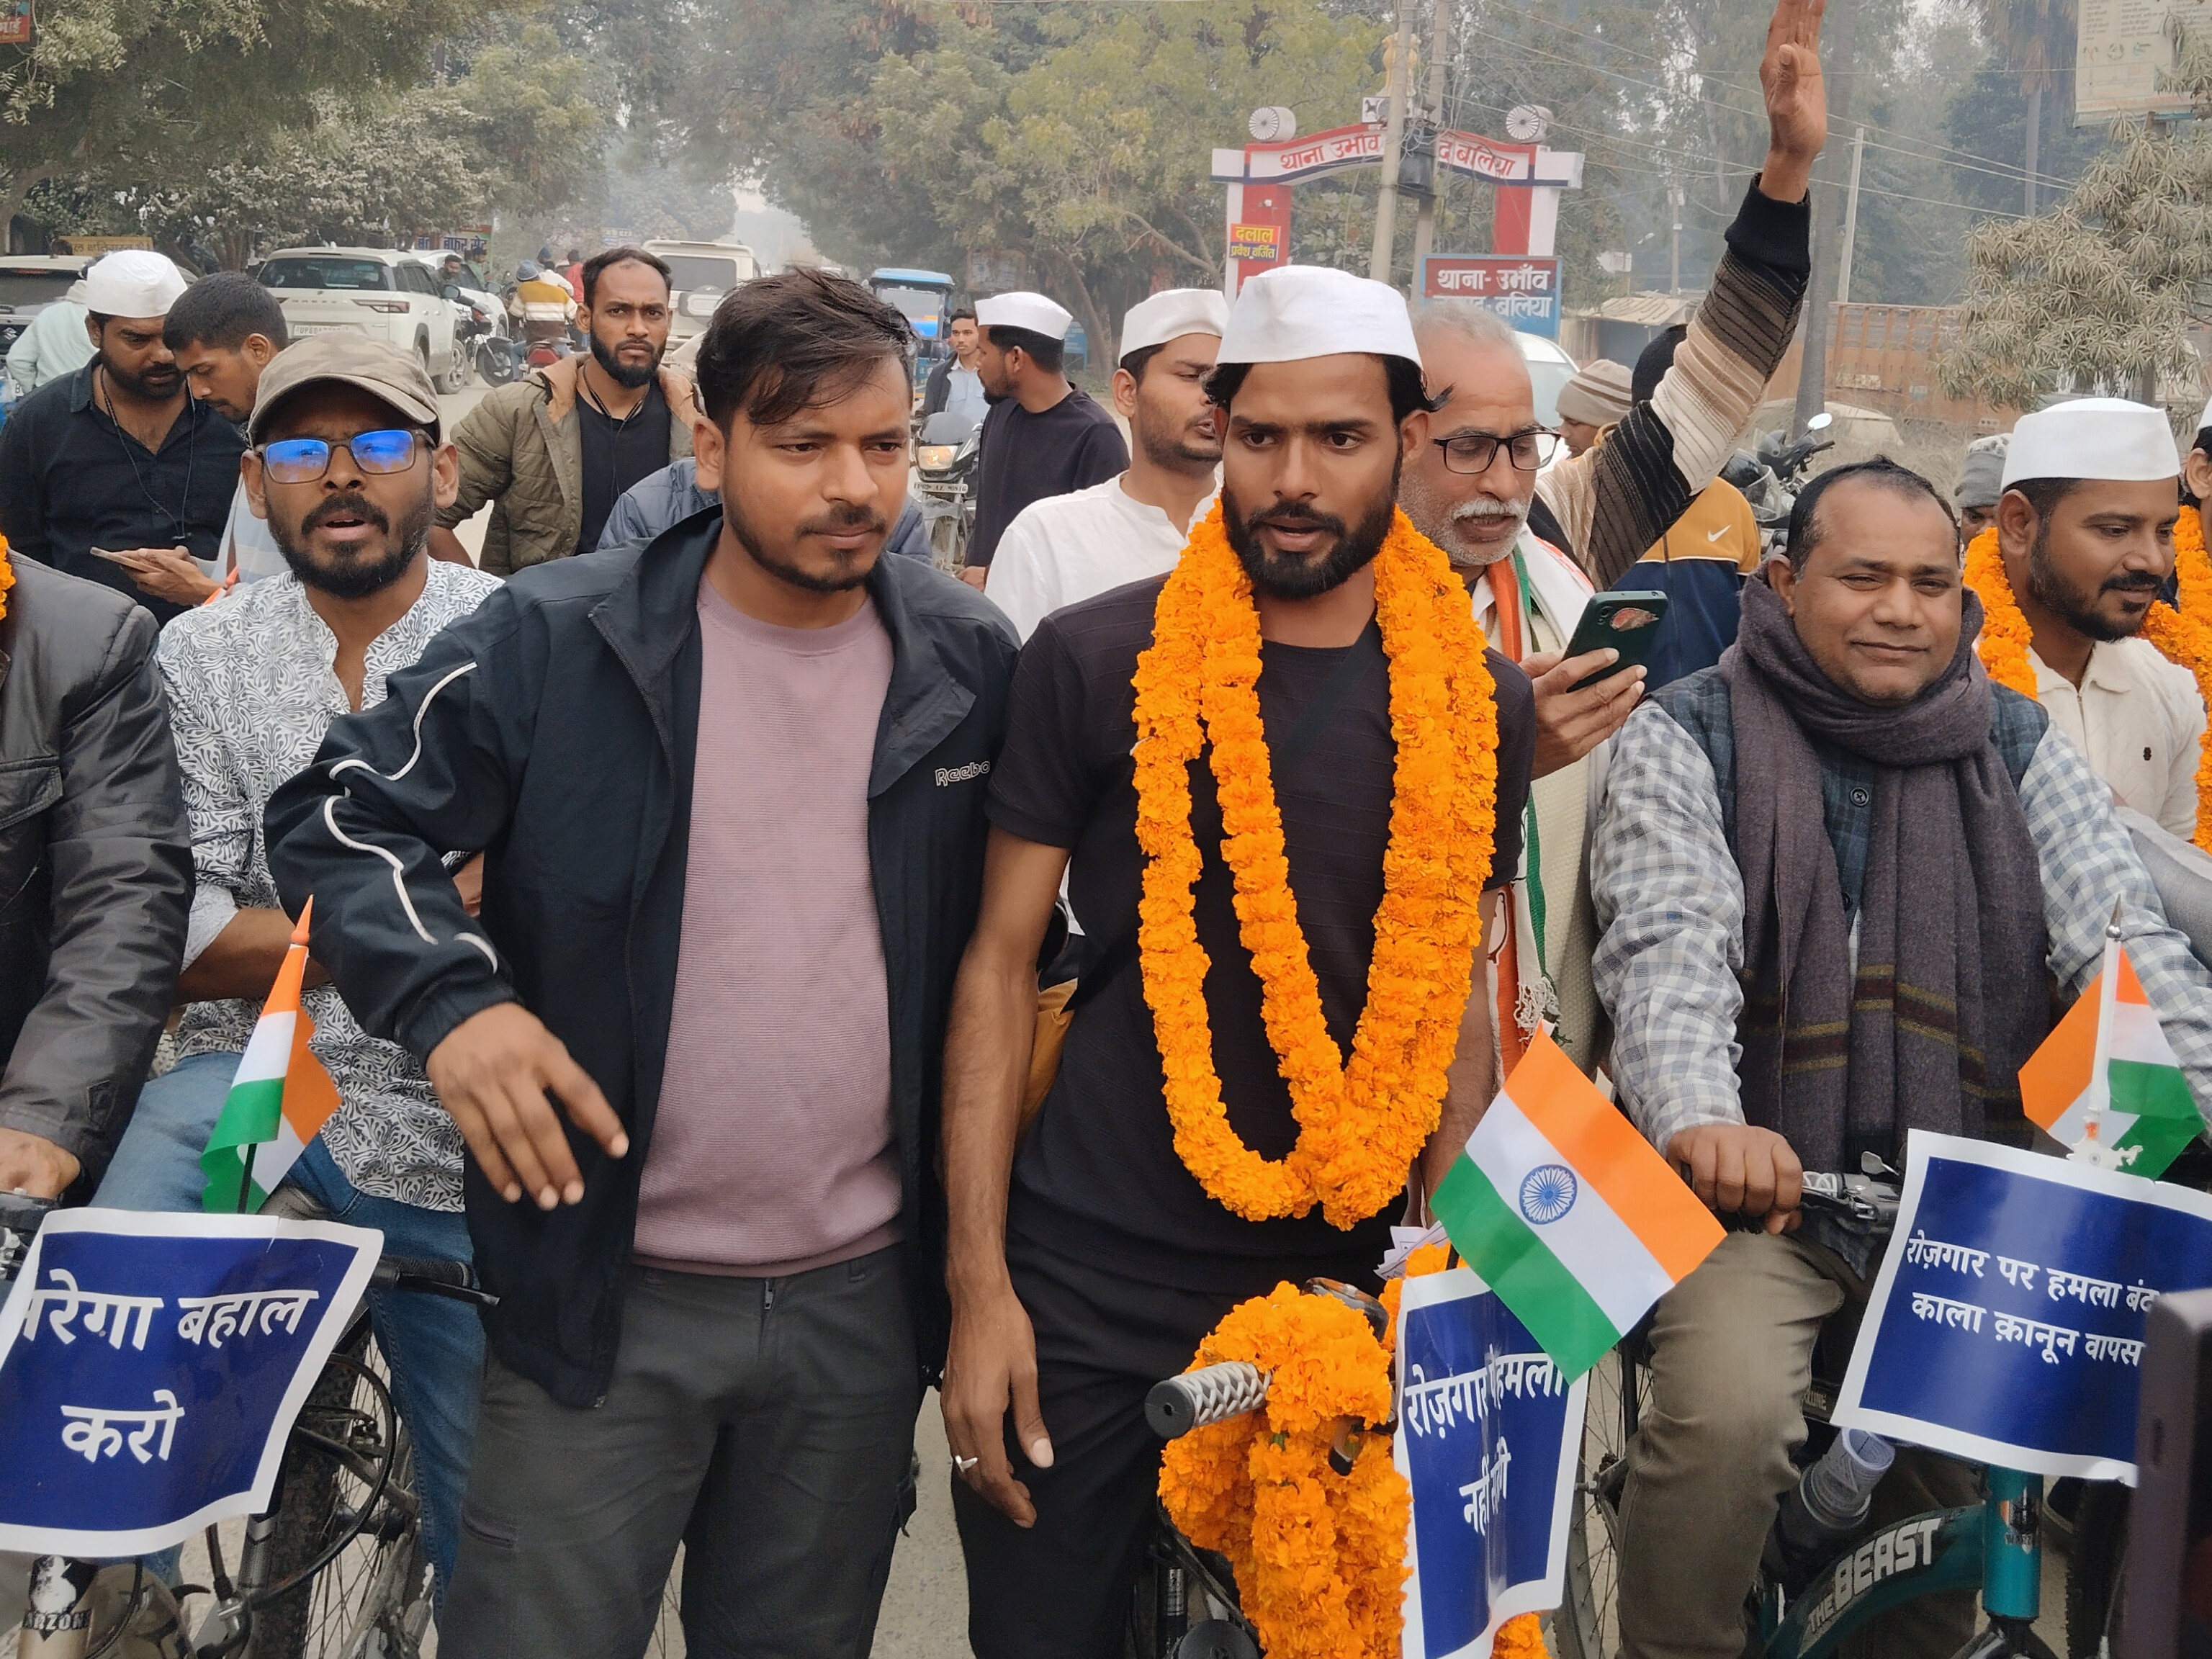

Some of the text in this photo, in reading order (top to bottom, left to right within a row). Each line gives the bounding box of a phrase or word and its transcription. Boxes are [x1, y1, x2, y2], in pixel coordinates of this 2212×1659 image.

[1280, 145, 1324, 168] थाना
[1236, 227, 1273, 242] दलाल
[1252, 245, 1275, 258] वर्जित
[1494, 292, 1552, 319] बलिया
[1907, 1229, 1990, 1278] रोज़गार
[1997, 1256, 2040, 1290] पर
[2046, 1268, 2123, 1309] हमला
[178, 1290, 319, 1348] बहाल
[1912, 1292, 2146, 1367] काला क़ानून वापस
[60, 1389, 185, 1465] करो
[1405, 1363, 1488, 1439] रोज़गार
[1496, 1353, 1563, 1411] हमला
[1459, 1453, 1490, 1537] नहीं
[1807, 1517, 1942, 1633] THE BEAST
